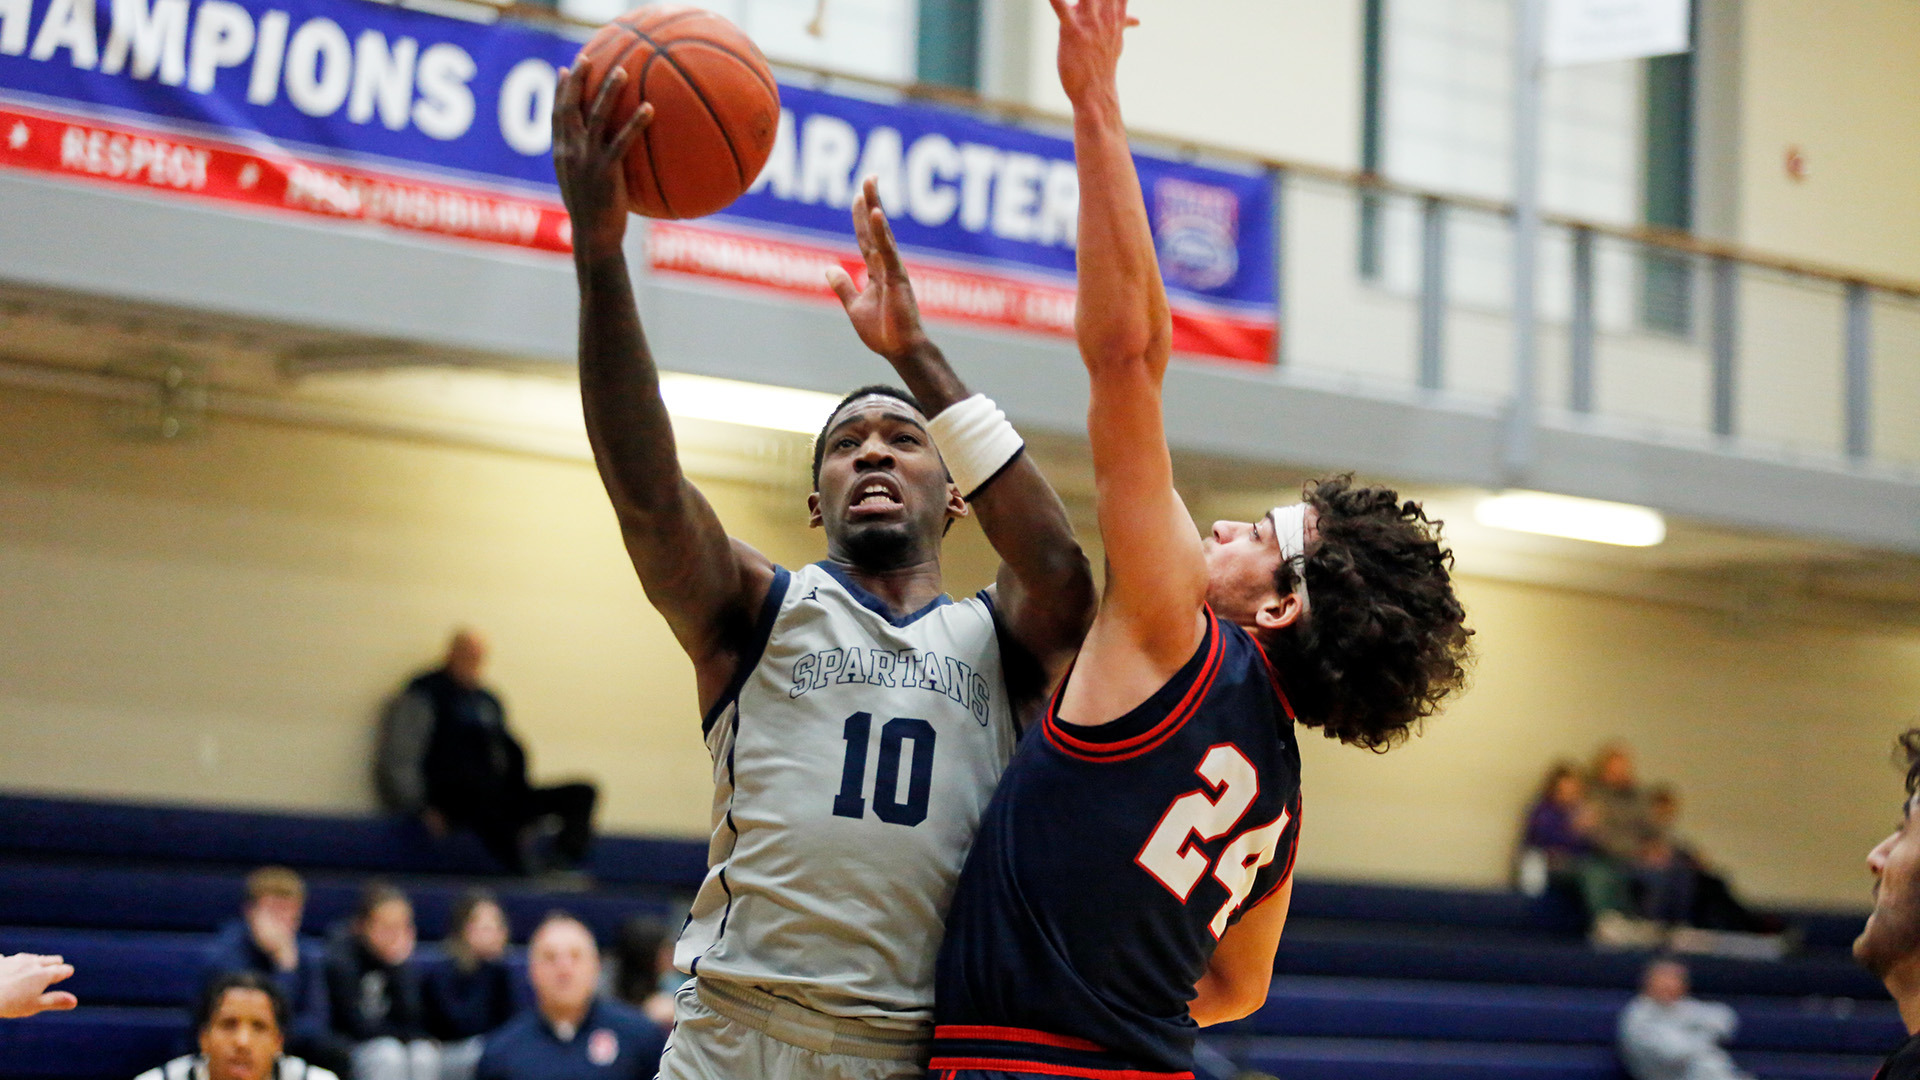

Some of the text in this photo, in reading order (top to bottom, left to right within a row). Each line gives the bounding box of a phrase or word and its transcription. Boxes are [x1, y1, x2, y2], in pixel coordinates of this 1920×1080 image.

[498, 57, 556, 156] O
[746, 106, 1080, 251] ARACTER
[790, 647, 990, 727] SPARTANS
[832, 711, 937, 828] 10
[1133, 741, 1293, 942] 24
